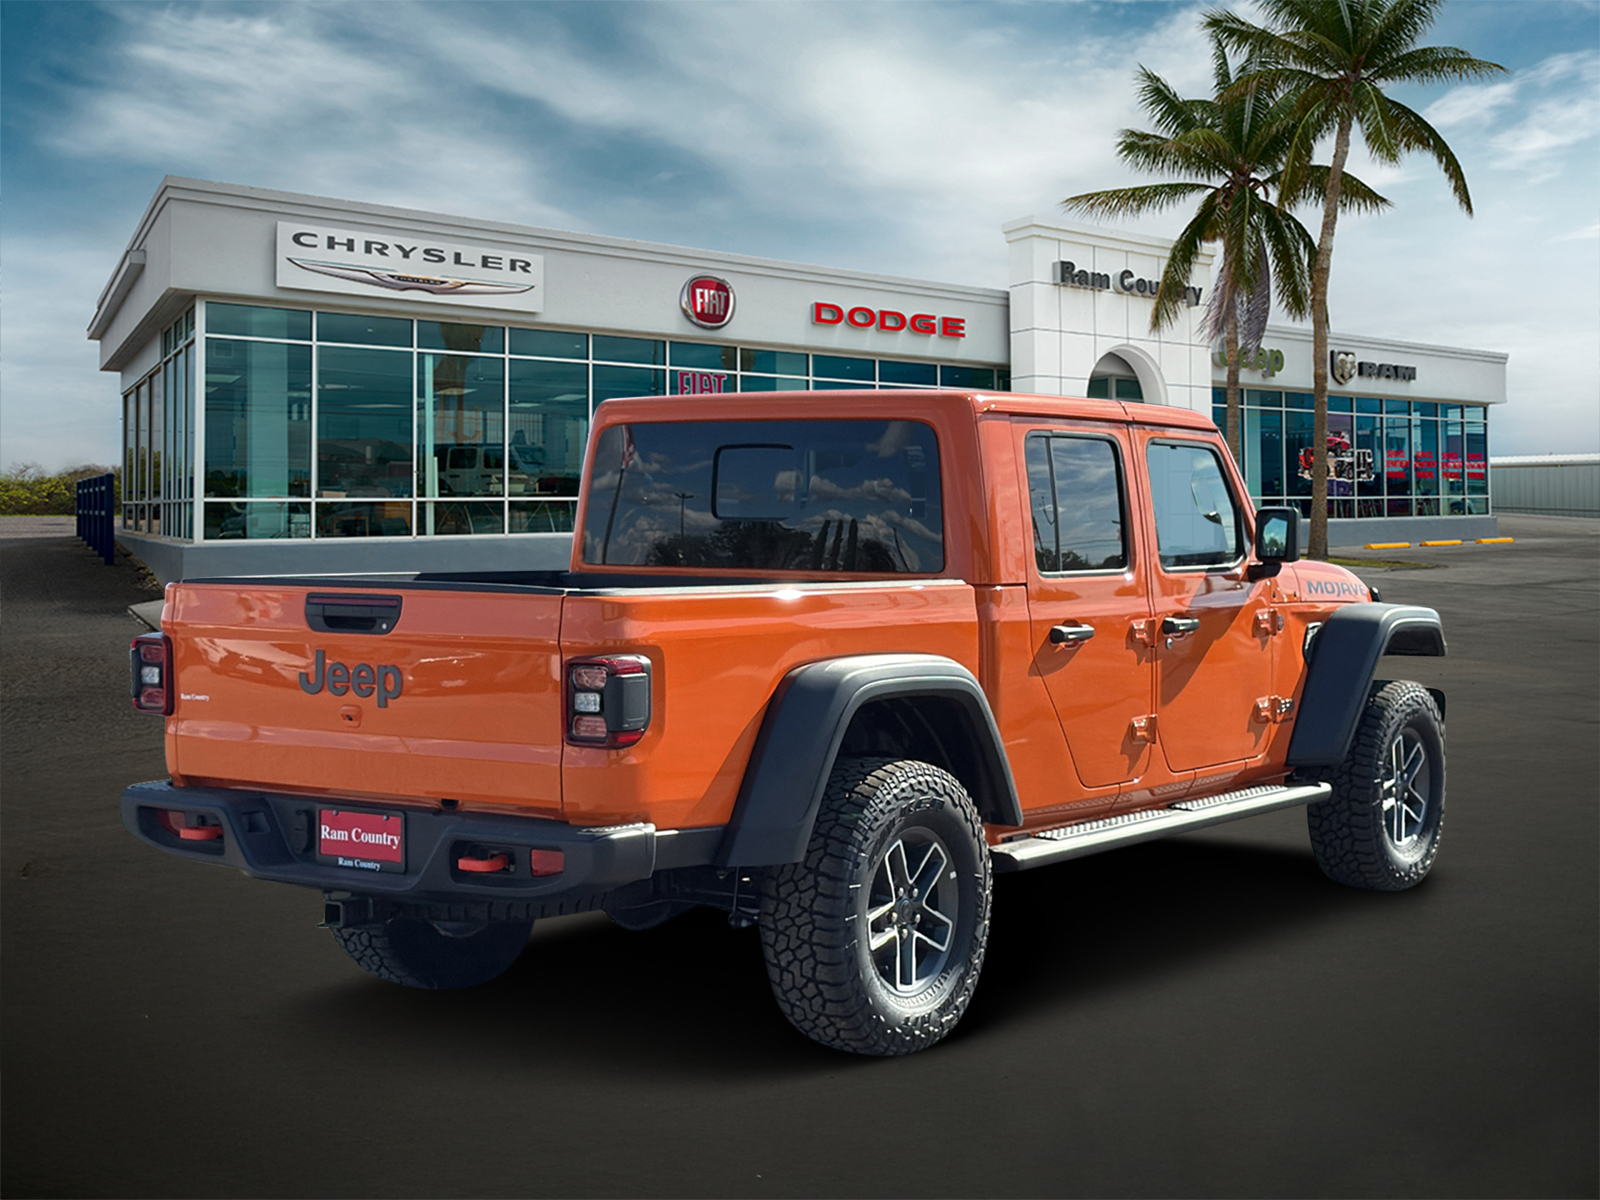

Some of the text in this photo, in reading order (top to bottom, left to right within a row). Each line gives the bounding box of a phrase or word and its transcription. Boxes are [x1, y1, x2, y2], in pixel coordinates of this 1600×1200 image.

[292, 232, 533, 274] CHRYSLER
[1056, 260, 1203, 306] Ram Coury
[695, 288, 728, 316] FIAT
[812, 302, 966, 338] DODGE
[678, 371, 727, 395] FIAT
[1359, 362, 1417, 381] RAM
[1306, 581, 1367, 598] MOJAVE
[299, 649, 403, 708] Jeep
[321, 824, 400, 850] Ram Country
[338, 857, 381, 872] Ram Country
